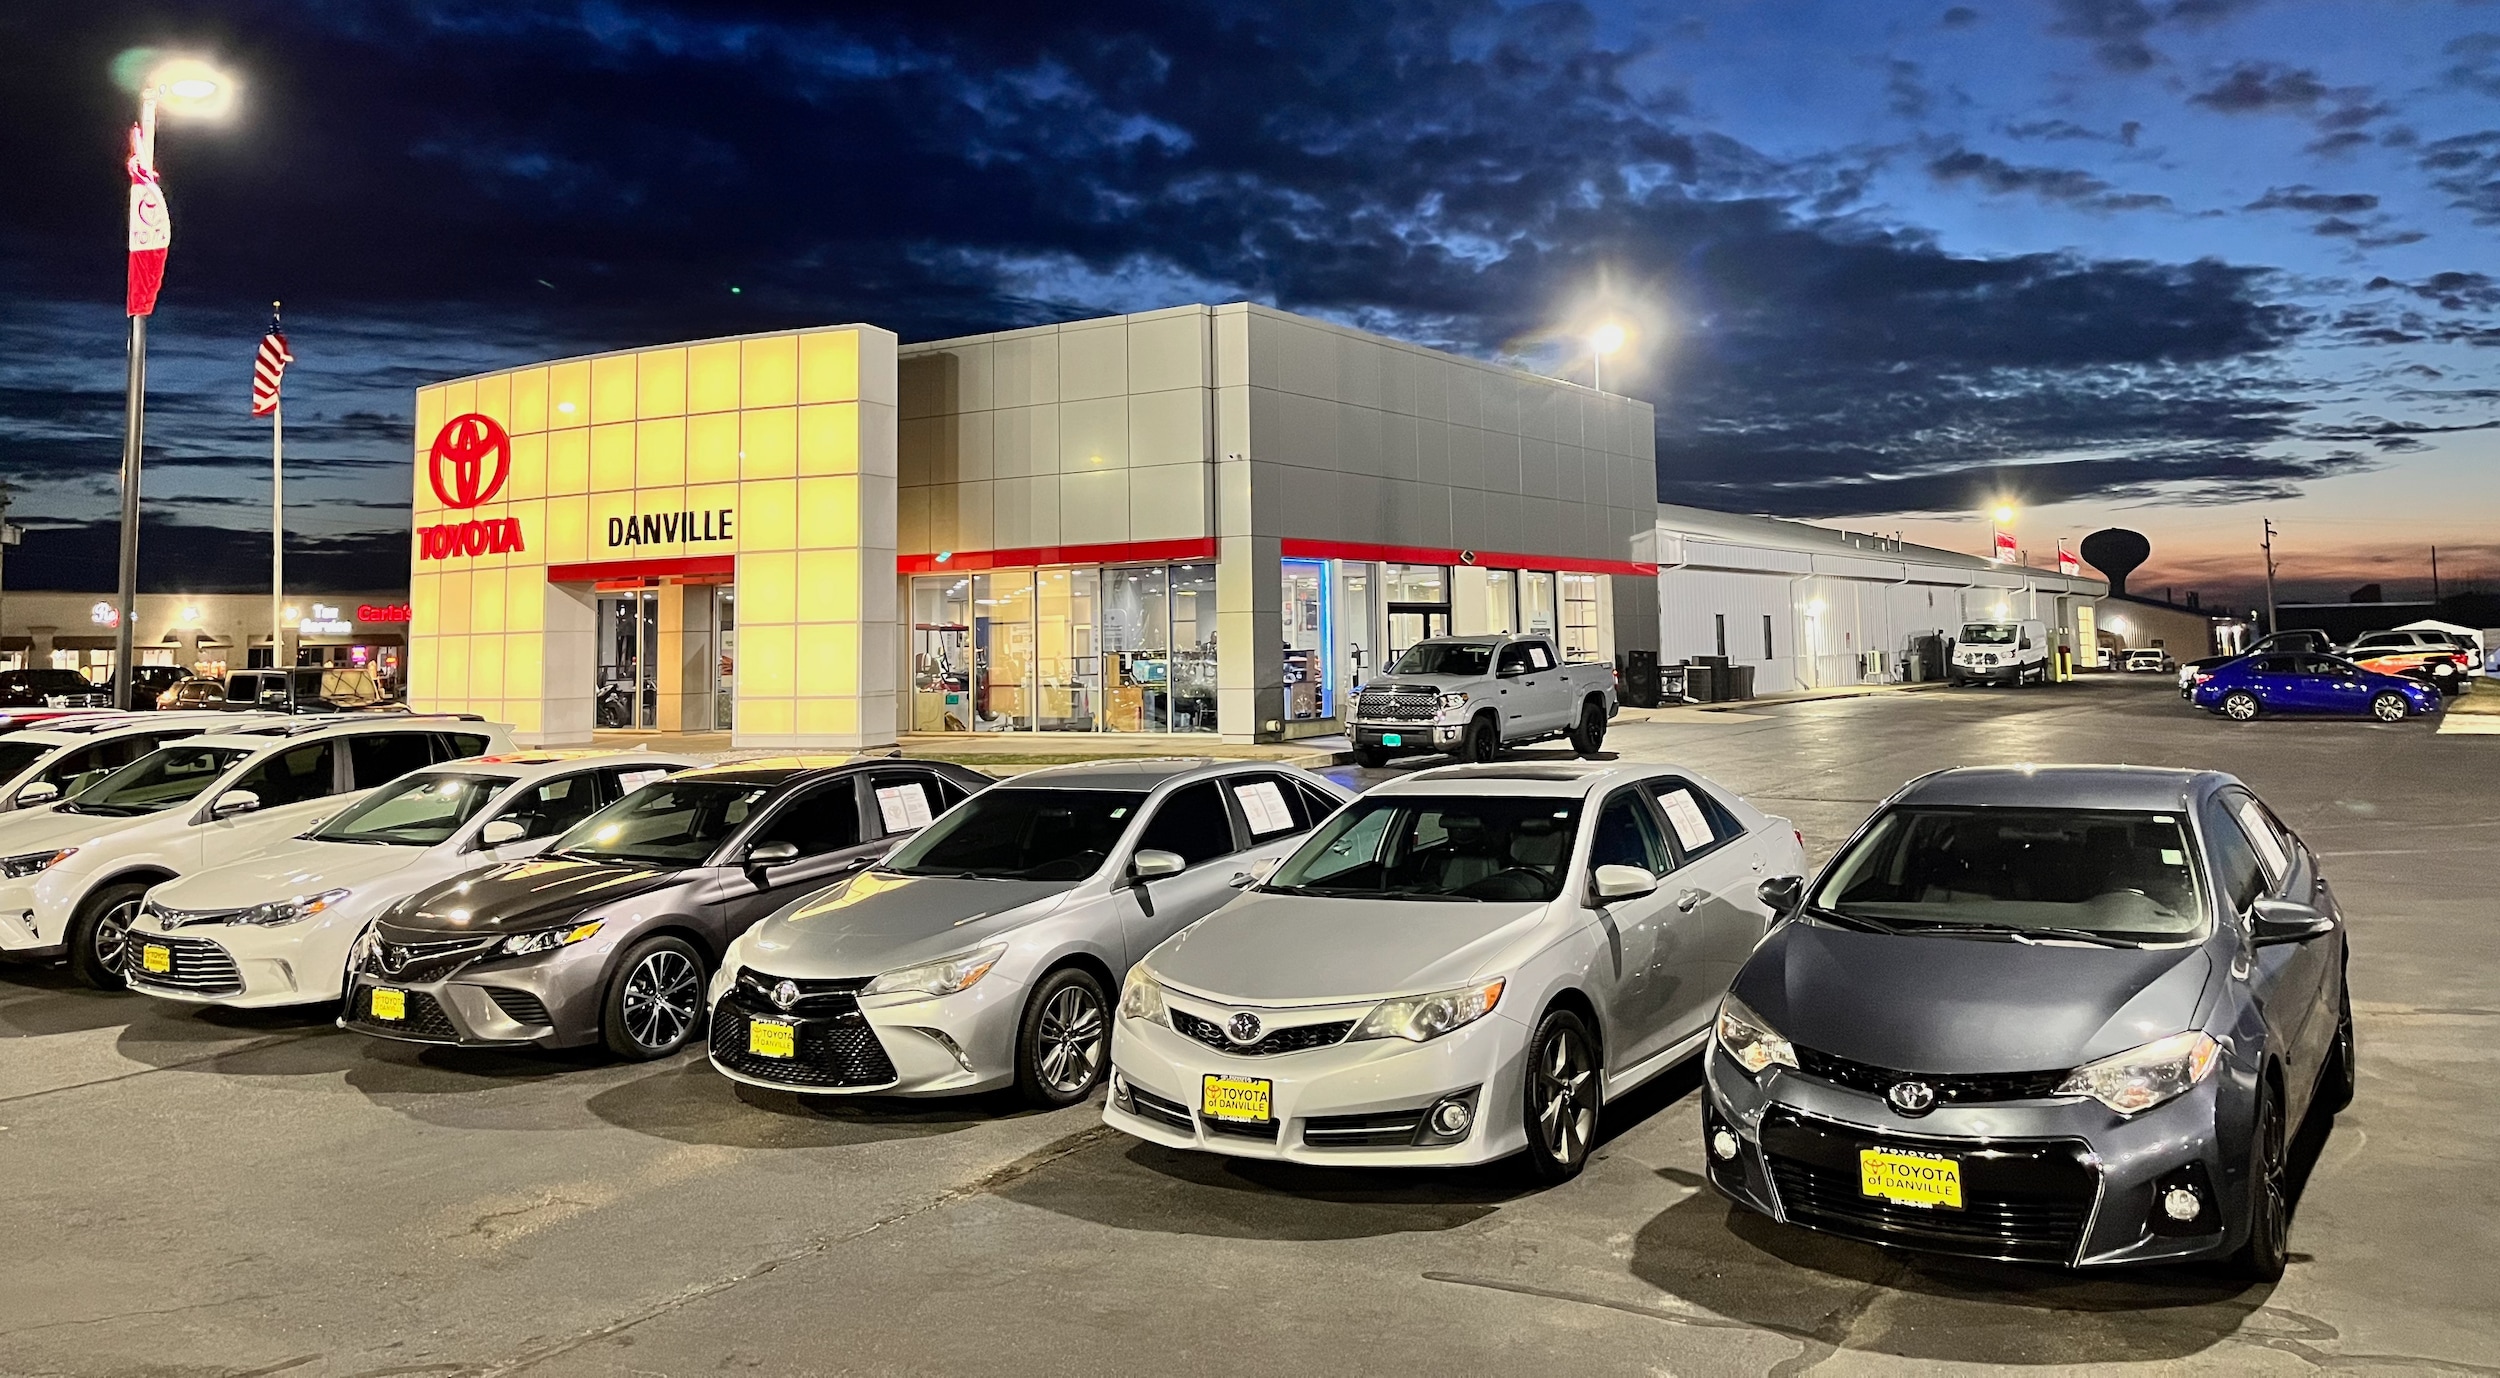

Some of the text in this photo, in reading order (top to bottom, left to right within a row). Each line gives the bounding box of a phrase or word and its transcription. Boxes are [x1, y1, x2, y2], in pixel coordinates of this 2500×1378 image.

[608, 509, 734, 547] DANVILLE
[417, 517, 525, 561] TOYOTA
[762, 1029, 794, 1041] TOYOTA
[1208, 1098, 1265, 1112] of DANVILLE
[1222, 1087, 1268, 1103] TOYOTA
[1888, 1163, 1957, 1184] TOYOTA
[1868, 1175, 1953, 1196] of DANVILLE
